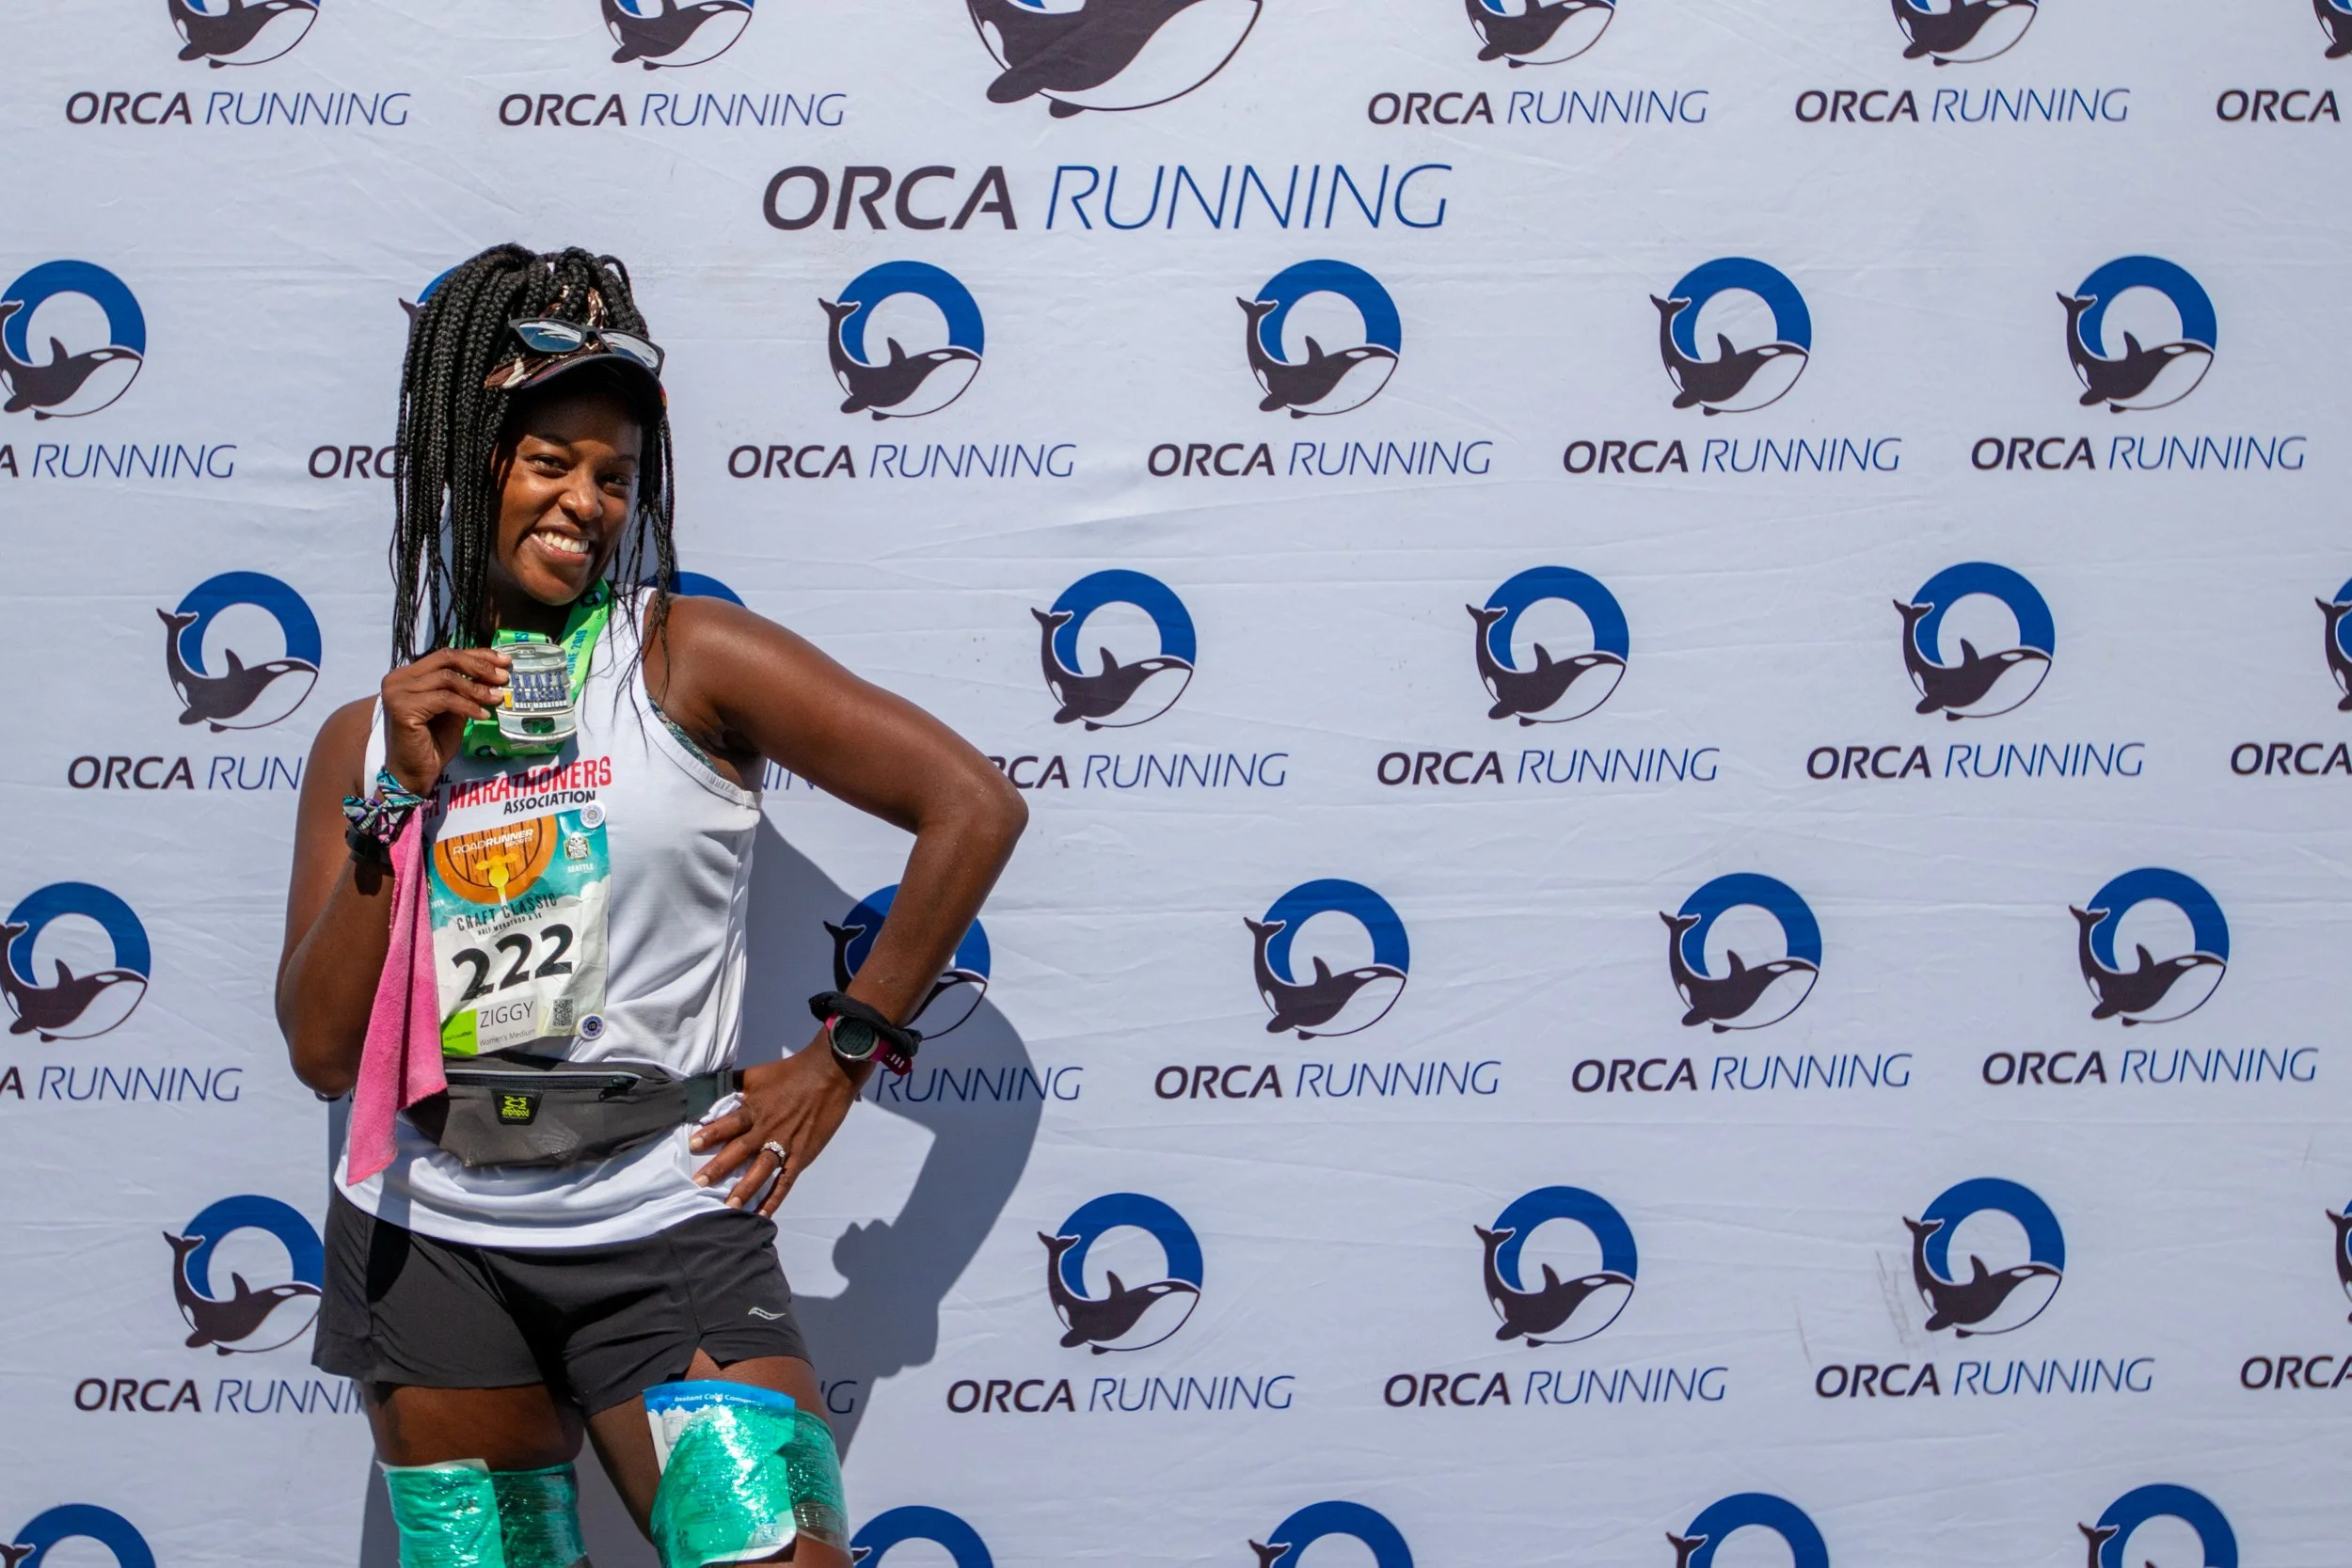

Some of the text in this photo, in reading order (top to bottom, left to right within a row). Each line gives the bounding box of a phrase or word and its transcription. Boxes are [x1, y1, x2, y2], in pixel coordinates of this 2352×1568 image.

[65, 91, 411, 126] ORCA RUNNING
[499, 93, 848, 127] ORCA RUNNING
[1367, 89, 1709, 125] ORCA RUNNING
[1794, 88, 2131, 123] ORCA RUNNING
[2217, 88, 2341, 122] ORCA
[762, 164, 1454, 231] ORCA RUNNING
[32, 443, 237, 479] RUNNING
[308, 445, 399, 479] ORC
[727, 443, 1077, 479] ORCA RUNNING
[1147, 440, 1494, 478] ORCA RUNNING
[1563, 436, 1902, 474] ORCA RUNNING
[1971, 436, 2307, 471] ORCA RUNNING
[67, 755, 195, 790] ORCA
[988, 752, 1289, 789] CA RUNNING
[1376, 747, 1721, 786] ORCA RUNNING
[1806, 742, 2146, 780] ORCA RUNNING
[2230, 741, 2352, 776] ORCA
[446, 755, 612, 812] MARATHONERS
[503, 790, 596, 816] ASSOCIATION
[567, 863, 595, 874] SEATTLE
[456, 893, 558, 931] CRAFT CLASSIC
[451, 923, 575, 1003] 222
[480, 1000, 534, 1029] ZIGGY
[479, 1034, 509, 1047] Women's
[509, 1027, 536, 1040] Medium
[38, 1066, 244, 1102] RUNNING
[876, 1067, 1084, 1102] RUNNING
[1153, 1060, 1502, 1100] ORCA RUNNING
[1571, 1053, 1913, 1094] ORCA RUNNING
[1981, 1047, 2319, 1086] ORCA RUNNING
[1383, 1366, 1729, 1408] ORCA RUNNING
[1815, 1356, 2155, 1399] ORCA RUNNING
[2240, 1354, 2352, 1390] ORCA
[73, 1377, 362, 1415] ORCA RUNNI
[675, 1394, 703, 1402] Instant
[946, 1374, 1295, 1414] ORCA RUNNING
